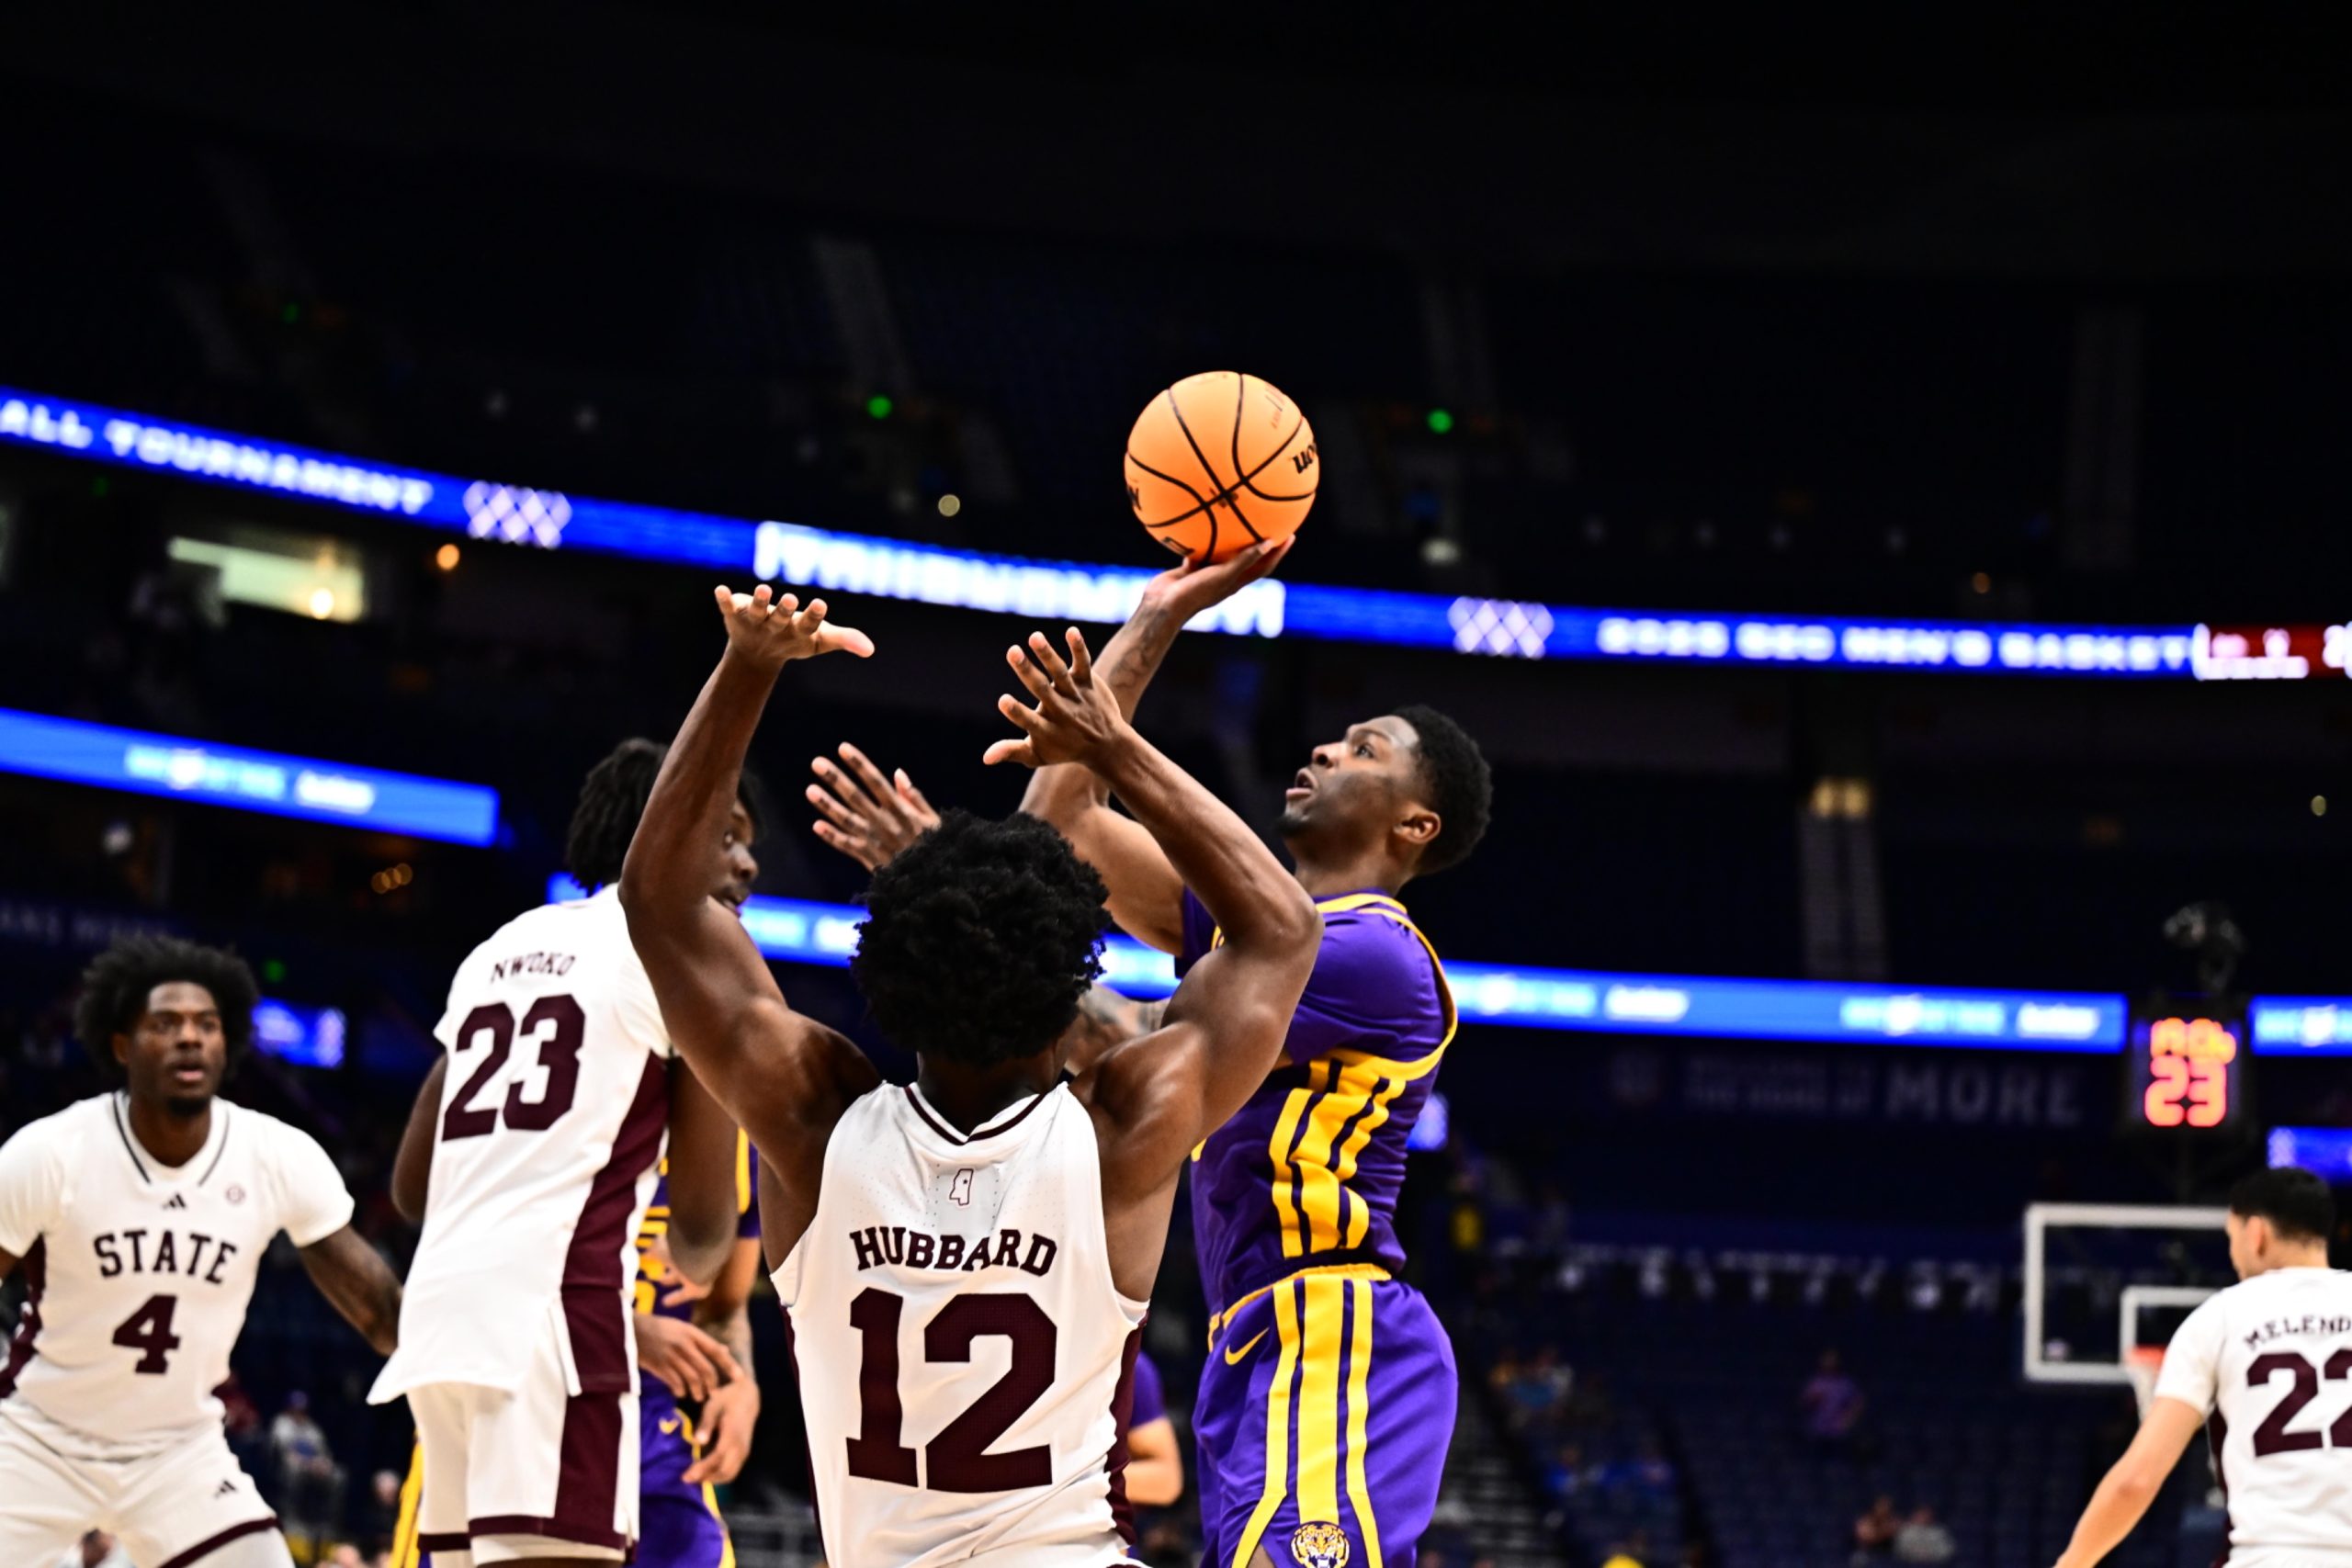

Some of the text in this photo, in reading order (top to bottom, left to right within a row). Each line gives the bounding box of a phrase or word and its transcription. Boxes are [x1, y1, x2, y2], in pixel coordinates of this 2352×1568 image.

[106, 420, 432, 513] TOURNAMENT
[491, 950, 577, 984] NWOKO
[441, 993, 586, 1143] 23
[1886, 1060, 2082, 1127] MORE
[2145, 1055, 2227, 1126] 23
[94, 1229, 237, 1285] STATE
[849, 1225, 1057, 1278] HUBBARD
[111, 1293, 181, 1375] 4
[845, 1286, 1057, 1495] 12
